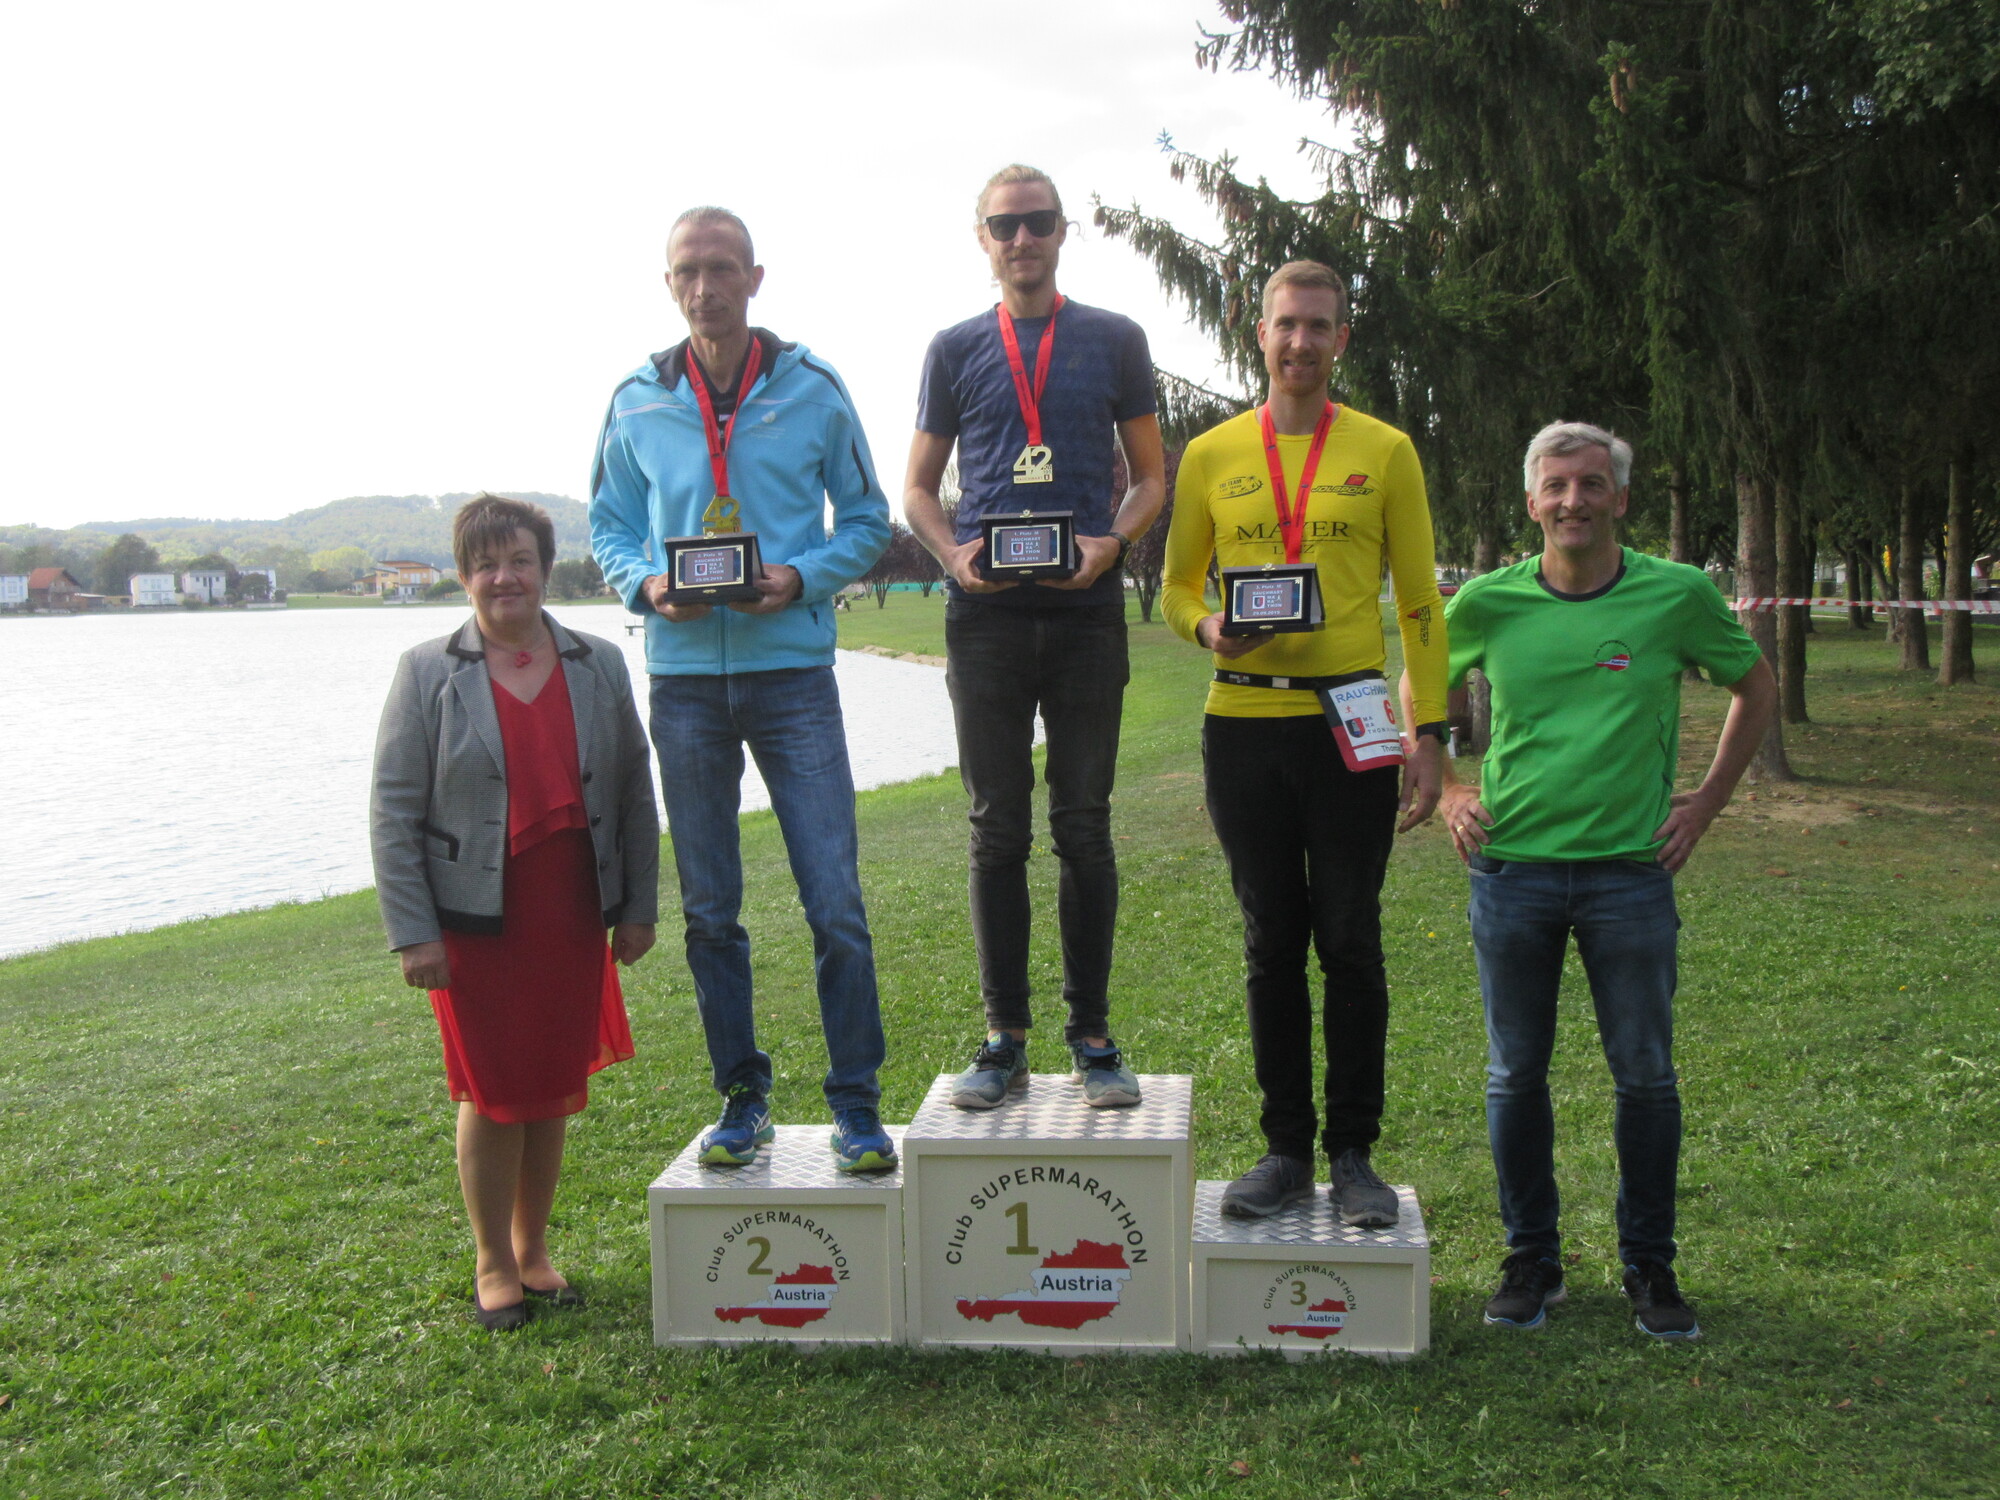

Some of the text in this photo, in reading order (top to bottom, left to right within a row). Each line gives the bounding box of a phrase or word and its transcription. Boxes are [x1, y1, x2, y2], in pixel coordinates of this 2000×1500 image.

[1013, 445, 1052, 476] 42
[702, 496, 740, 526] 42
[1273, 544, 1315, 555] LZ
[946, 1166, 1148, 1265] Club SUPERMARATHON
[1004, 1201, 1039, 1255] 1
[706, 1211, 850, 1283] Club SUPERMARATHON
[746, 1236, 774, 1276] 2
[774, 1288, 826, 1301] Austria
[1040, 1275, 1113, 1291] Austria
[1263, 1264, 1357, 1310] Club SUPERMARATHON
[1290, 1280, 1308, 1306] 3
[1306, 1313, 1341, 1323] Austria
